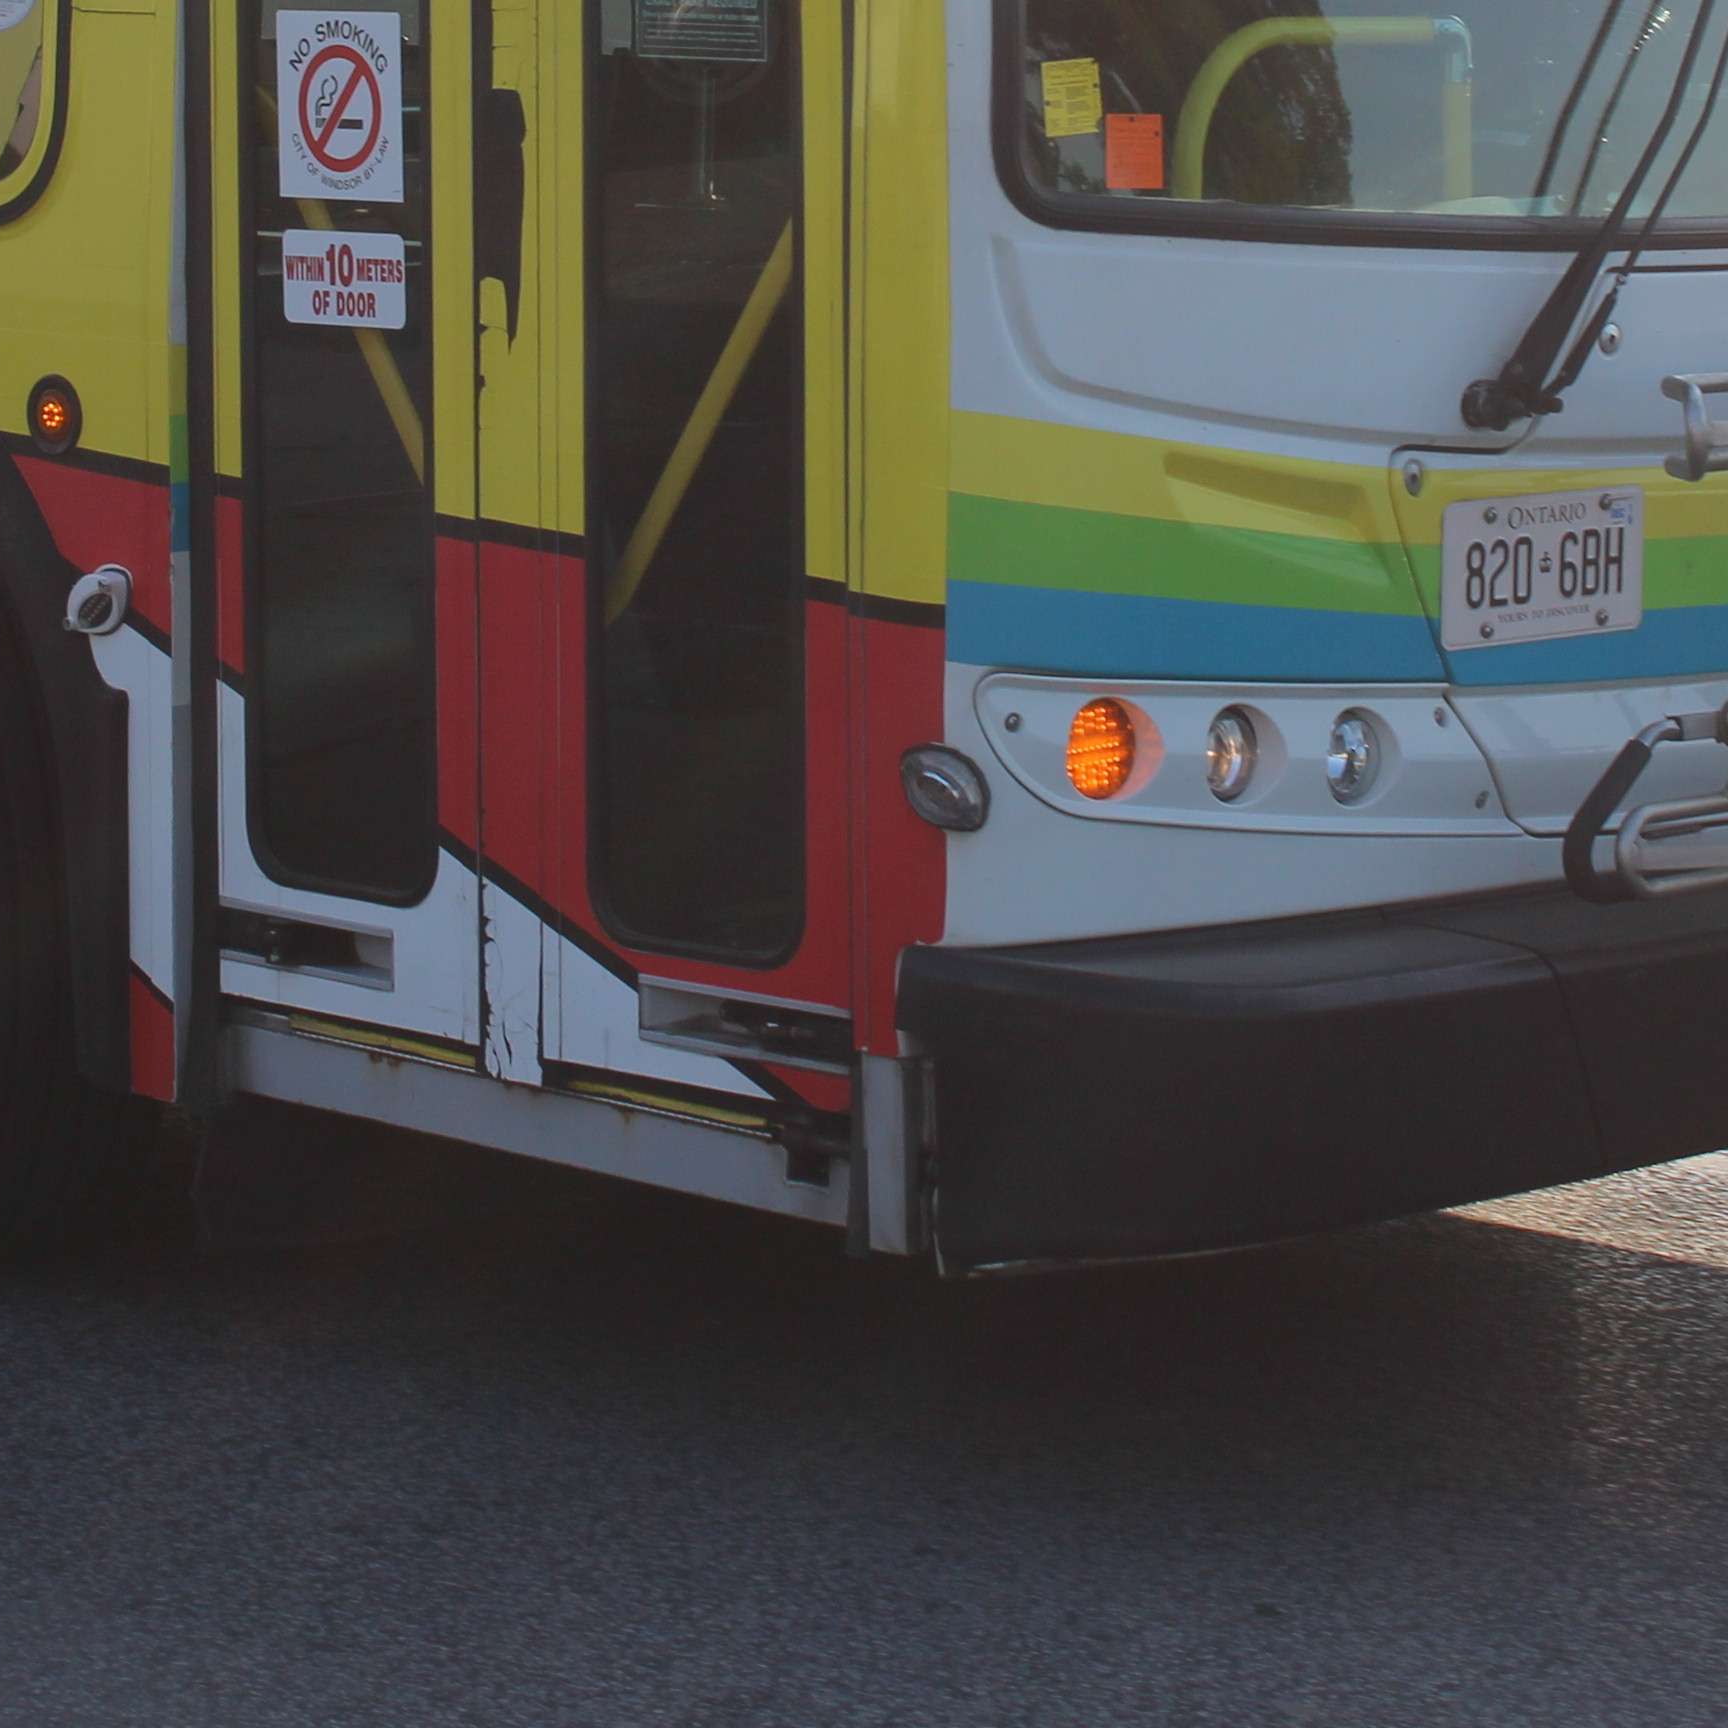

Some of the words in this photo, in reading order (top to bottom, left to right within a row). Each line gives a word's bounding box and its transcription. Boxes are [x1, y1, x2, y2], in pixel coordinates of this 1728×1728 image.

[288, 37, 312, 73] NO
[315, 19, 389, 75] SMOKING
[291, 132, 307, 160] CITY
[306, 161, 320, 177] OF
[320, 173, 365, 191] WINDSOR
[363, 135, 390, 181] BY-LAW
[285, 255, 324, 282] WITHIN
[326, 243, 354, 287] 10
[356, 257, 403, 284] METERS
[313, 289, 330, 315] OF
[336, 290, 376, 318] DOOR
[1507, 502, 1587, 530] ONTARIO
[1465, 535, 1533, 610] 820
[1558, 526, 1624, 599] 6BH
